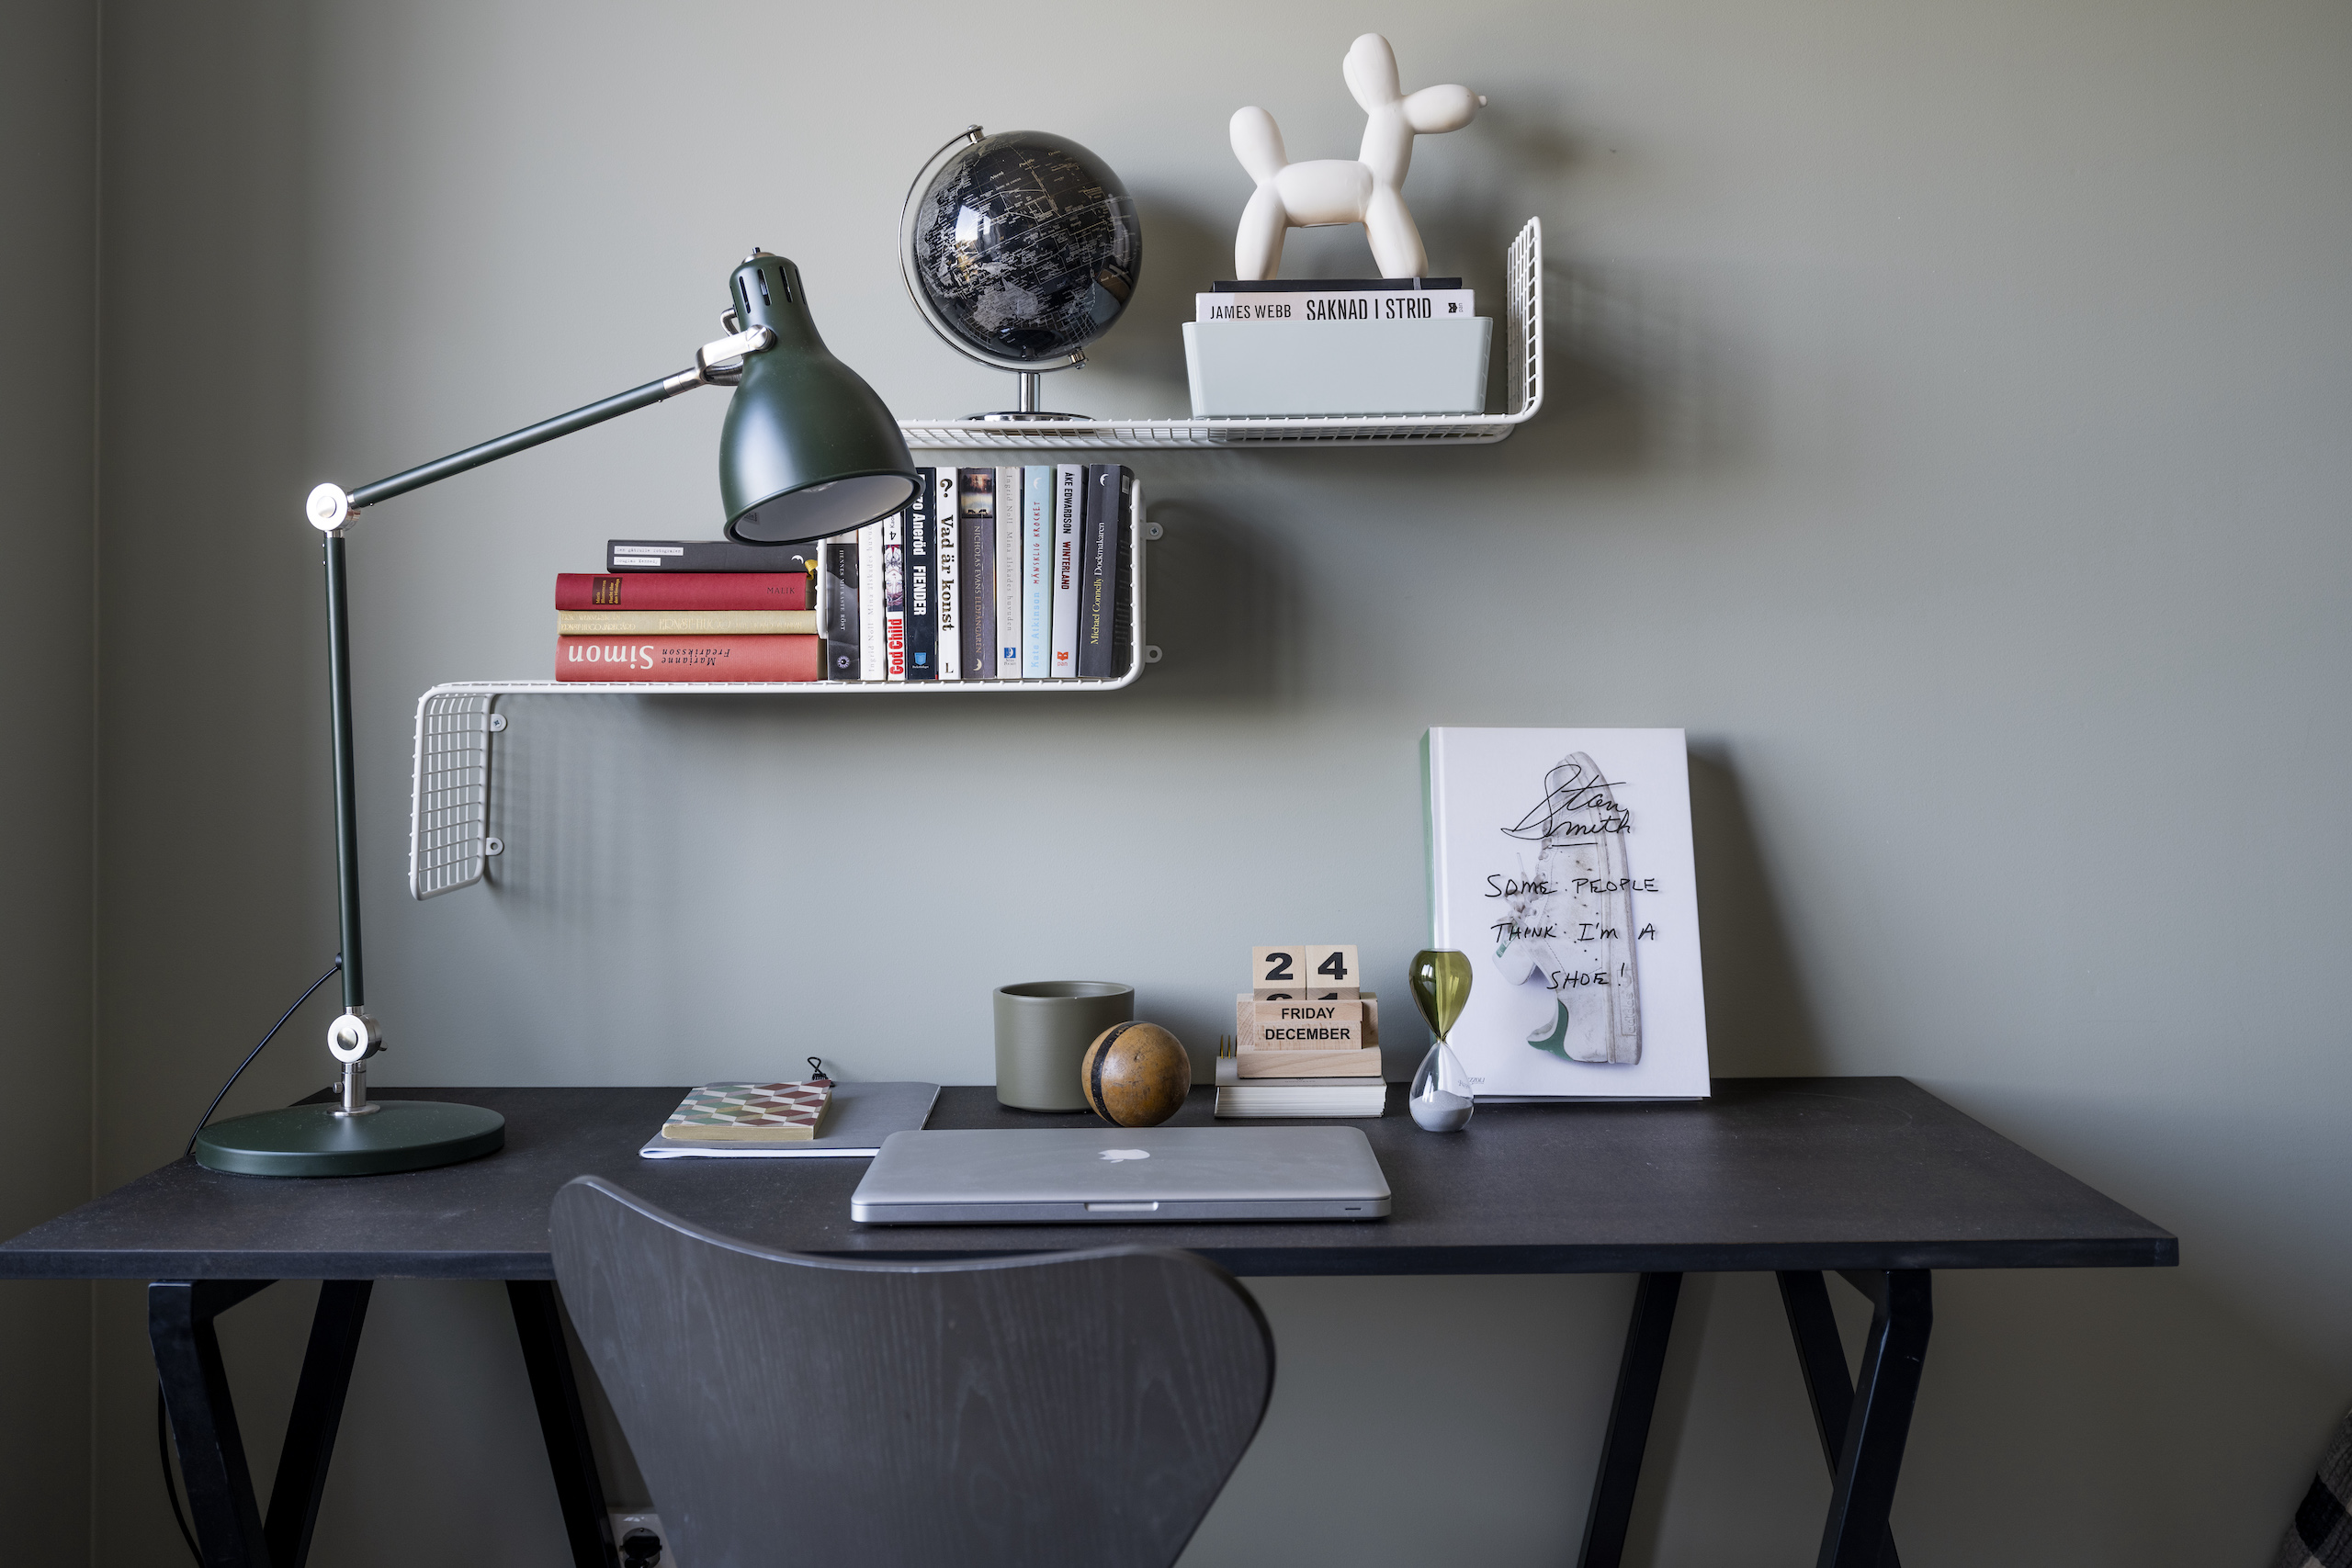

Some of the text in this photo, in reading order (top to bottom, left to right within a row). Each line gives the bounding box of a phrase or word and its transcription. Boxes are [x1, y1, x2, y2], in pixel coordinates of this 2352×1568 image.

[1210, 304, 1292, 320] JAMES WEBB
[1306, 298, 1431, 321] SAKNAD I STRID
[889, 531, 897, 541] 4
[912, 513, 926, 556] Aneröd
[941, 514, 954, 549] Vad
[1061, 472, 1073, 590] ÅKE EDWARDSON WINTERLAND
[1031, 502, 1041, 584] MÄNSKLIG KROCKET
[941, 556, 955, 574] är
[913, 566, 927, 616] FIENDER
[1091, 522, 1105, 645] Michael Connelly Dockmakaren
[942, 580, 955, 632] konst
[659, 618, 731, 631] ERNST-HUGO
[1031, 592, 1040, 668] Kate Atkinson
[568, 645, 654, 670] Simon
[662, 649, 730, 658] Fredriksson
[888, 618, 904, 675] God Child
[662, 657, 717, 666] Marianne
[1485, 874, 1658, 897] SOME PEOPLE
[1491, 923, 1556, 942] THINK
[1638, 923, 1656, 941] A
[1282, 1007, 1335, 1020] FRIDAY
[1265, 1028, 1350, 1040] DECEMBER
